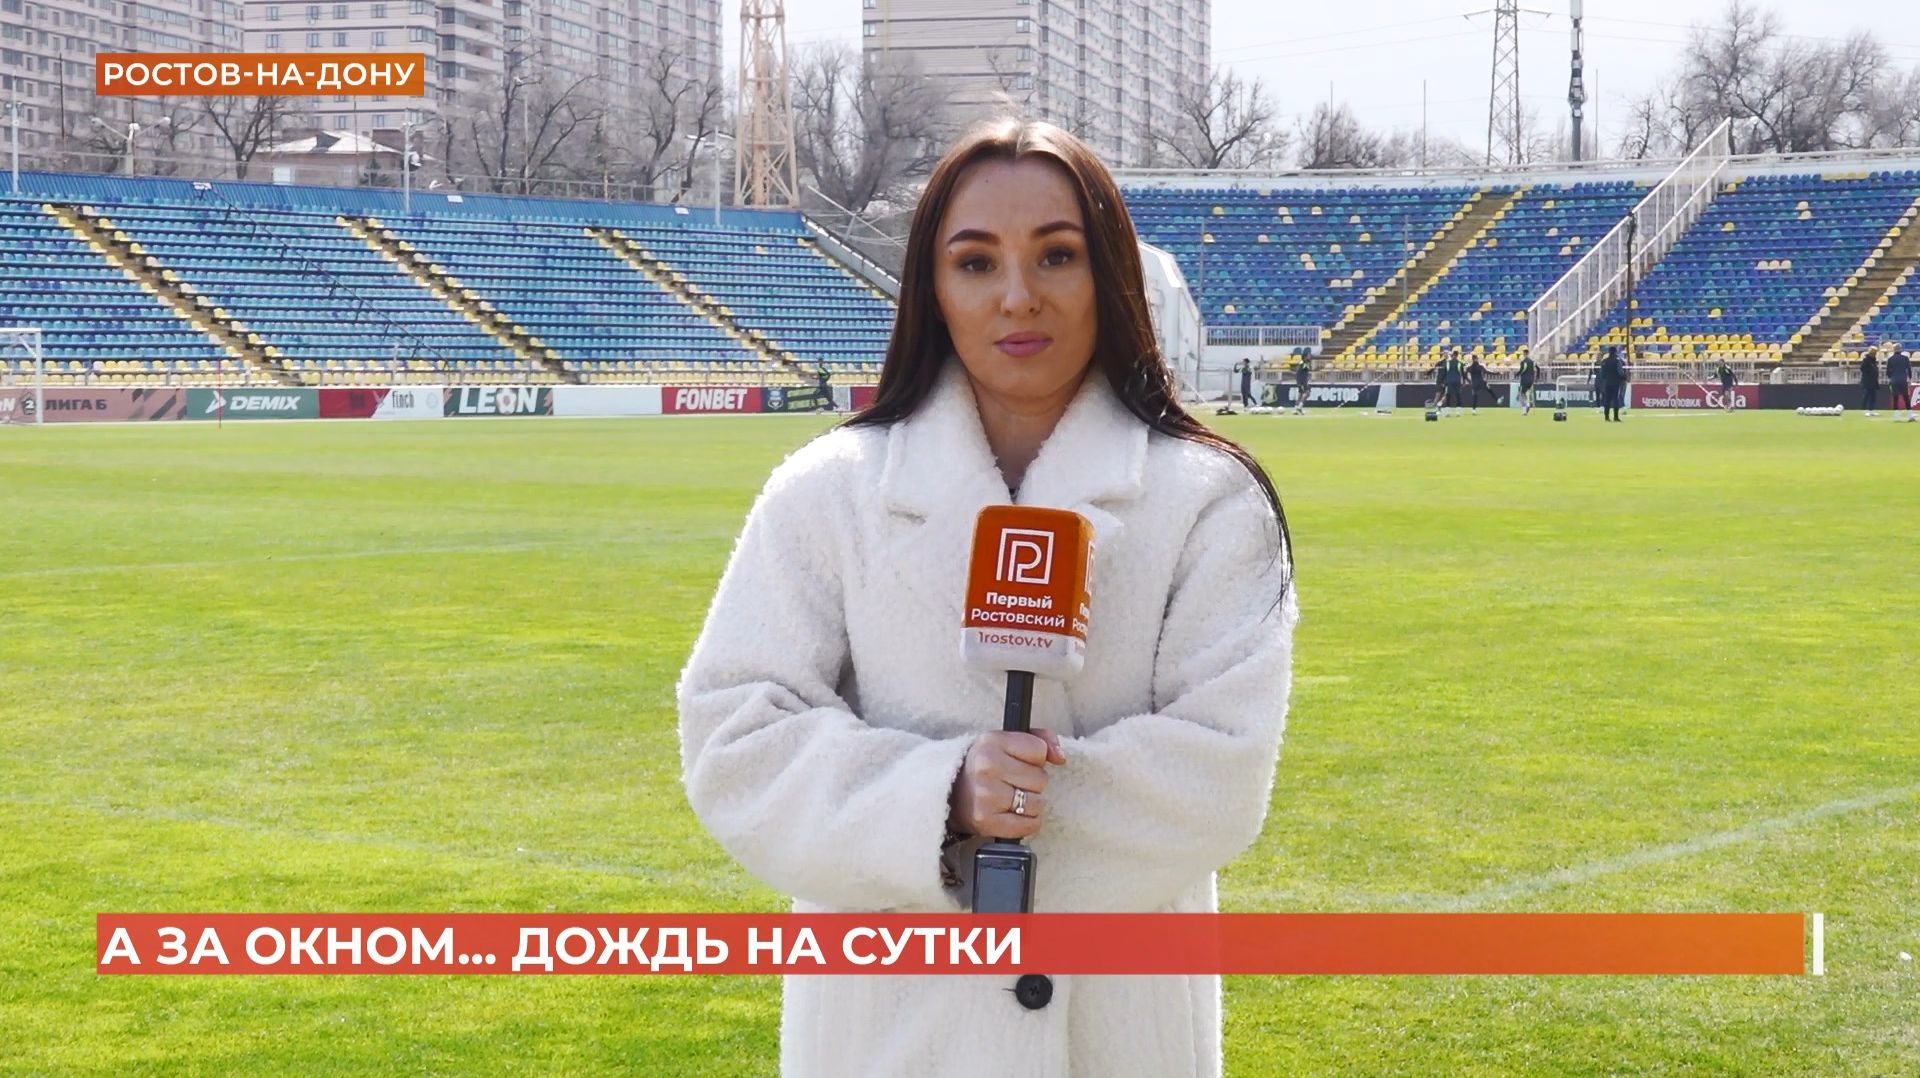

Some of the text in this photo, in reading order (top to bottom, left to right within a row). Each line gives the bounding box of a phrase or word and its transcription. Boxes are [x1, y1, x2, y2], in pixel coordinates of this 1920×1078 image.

[46, 399, 107, 411] ЛИГА Б
[230, 395, 301, 411] DEMIX
[675, 388, 748, 411] FONBET
[986, 592, 1053, 609] Первый
[971, 608, 1065, 628] Ростовский
[978, 631, 1053, 649] 1rostov.tv
